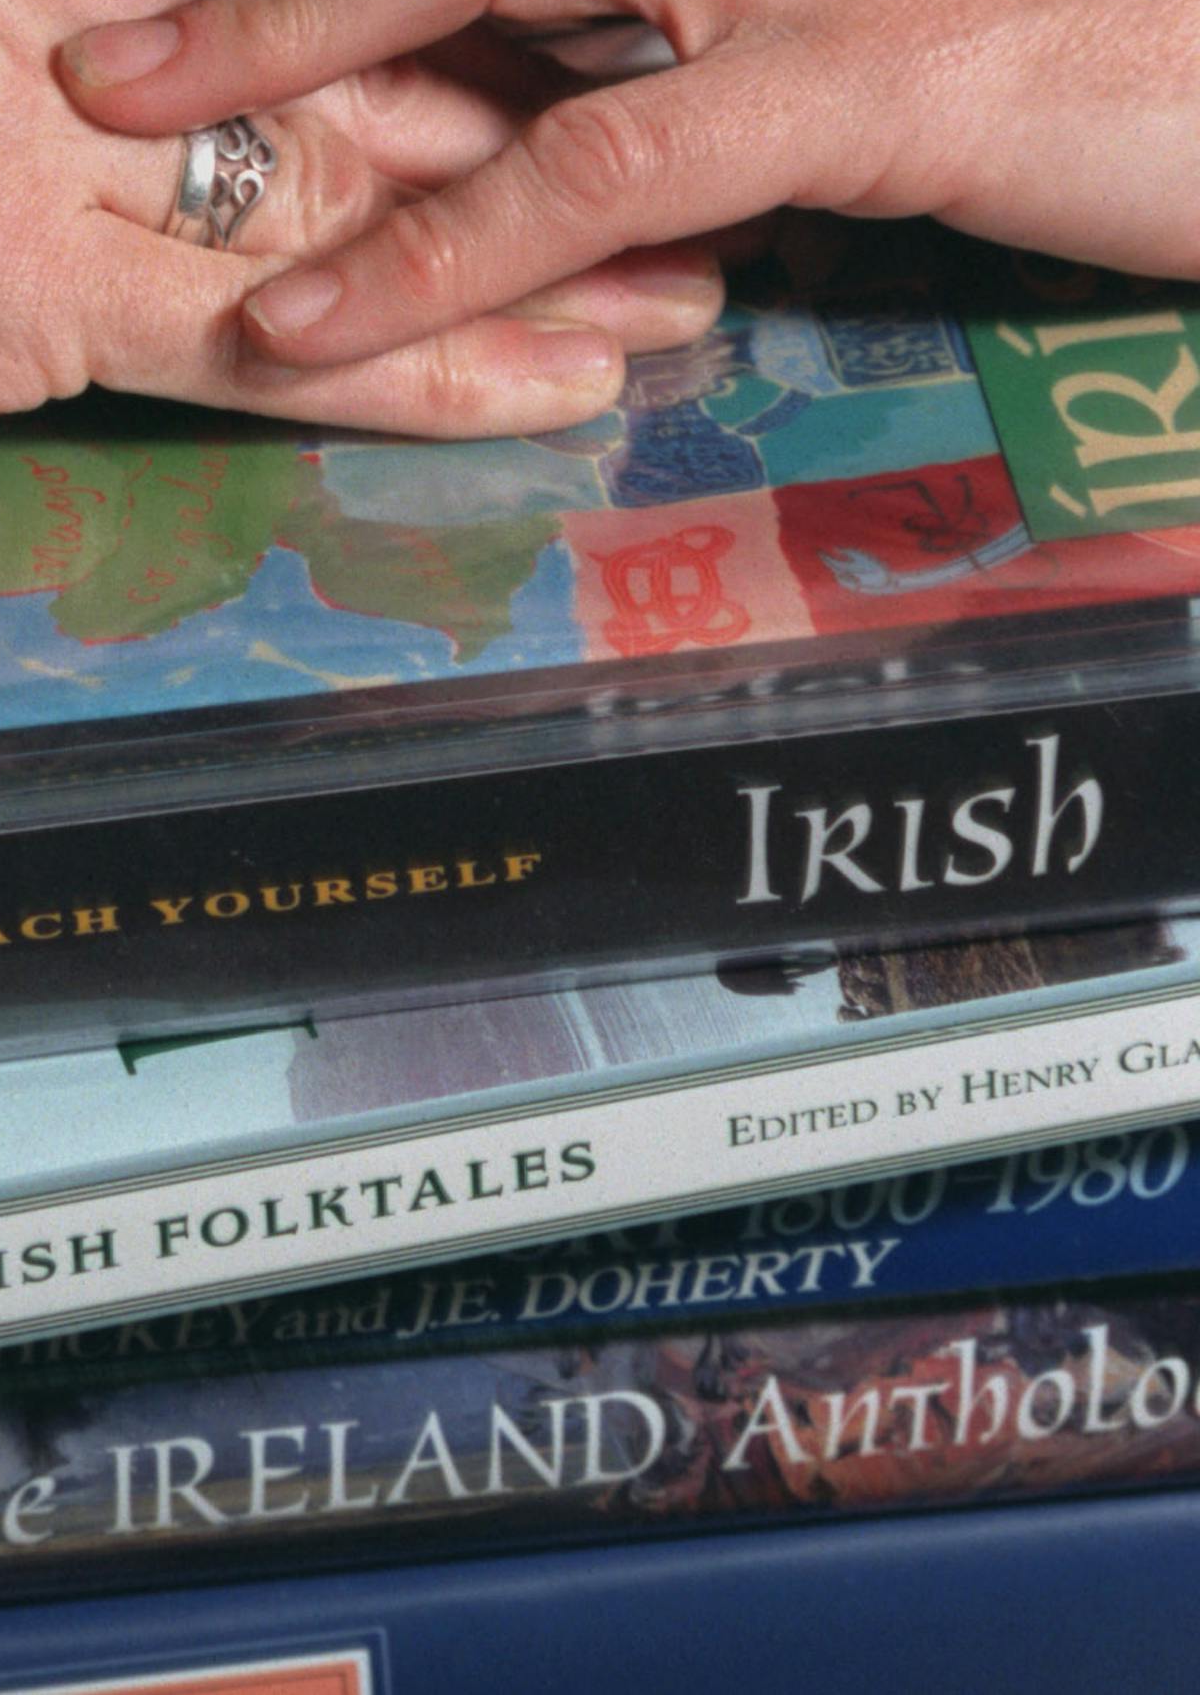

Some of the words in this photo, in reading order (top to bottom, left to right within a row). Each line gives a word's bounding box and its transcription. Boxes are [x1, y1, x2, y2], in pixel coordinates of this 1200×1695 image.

[151, 853, 542, 925] YOURSELF
[728, 1098, 880, 1148] EDITED
[898, 1085, 943, 1117] BY
[960, 1057, 1099, 1106] HENRY
[154, 1140, 598, 1259] FOLKTALES
[272, 1288, 393, 1342] and
[394, 1275, 501, 1339] J.E.
[515, 1238, 902, 1322] DOHERTY
[105, 1390, 668, 1536] IRELAND
[722, 1323, 1200, 1472] Antholo
